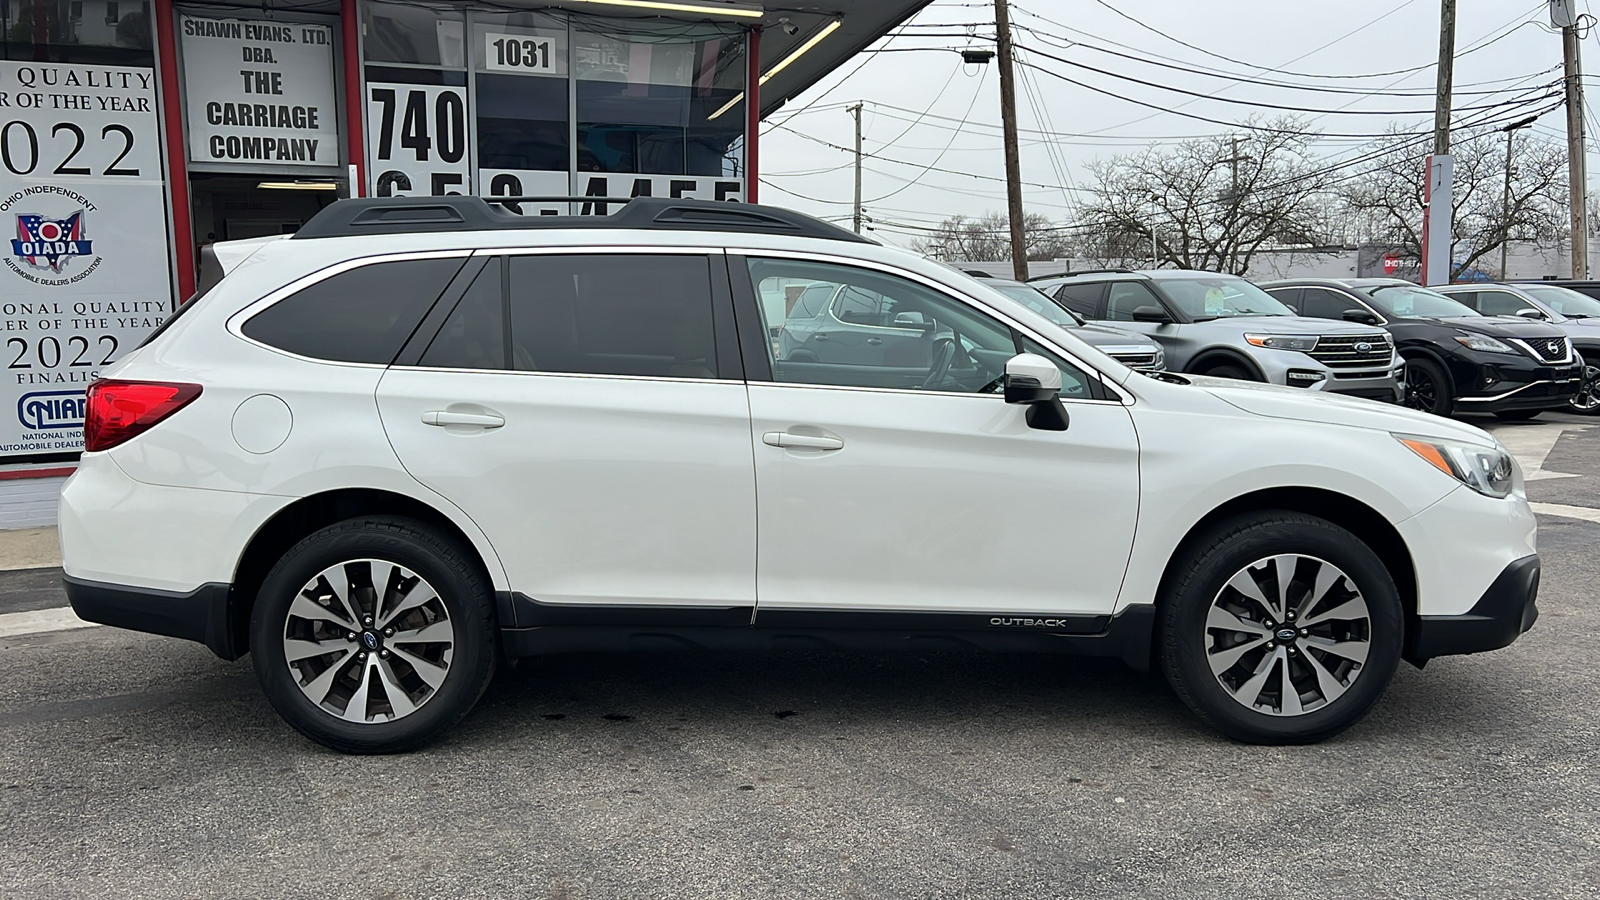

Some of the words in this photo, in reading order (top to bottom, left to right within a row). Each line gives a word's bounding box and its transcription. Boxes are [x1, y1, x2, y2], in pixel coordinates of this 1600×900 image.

[184, 19, 242, 40] SHAWN
[245, 24, 296, 43] EVANS.
[302, 28, 331, 46] LTD.
[242, 46, 278, 64] DBA.
[493, 38, 550, 69] 1031
[17, 67, 151, 89] QUALITY
[240, 70, 283, 95] THE
[16, 92, 44, 108] OF
[49, 93, 92, 110] THE
[97, 96, 151, 112] YEAR
[206, 101, 319, 129] CARRIAGE
[371, 88, 465, 163] 740
[209, 135, 319, 162] COMPANY
[0, 191, 23, 212] OHIO
[24, 185, 97, 212] INDEPENDENT
[21, 242, 79, 255] OIADA
[3, 257, 40, 284] AUTOMOBILE
[40, 278, 70, 286] DEALERS
[70, 256, 103, 284] ASSOCIATION
[3, 303, 63, 315] ONAL
[74, 301, 165, 315] QUALITY
[0, 319, 29, 331] ER
[38, 319, 62, 331] OF
[71, 318, 109, 330] THE
[117, 317, 164, 328] YEAR
[6, 335, 119, 369] 2022
[0, 442, 52, 451] AUTOMOBILE
[55, 440, 84, 448] DEALER
[22, 432, 64, 440] NATIONAL
[990, 618, 1067, 627] OUTBACK
